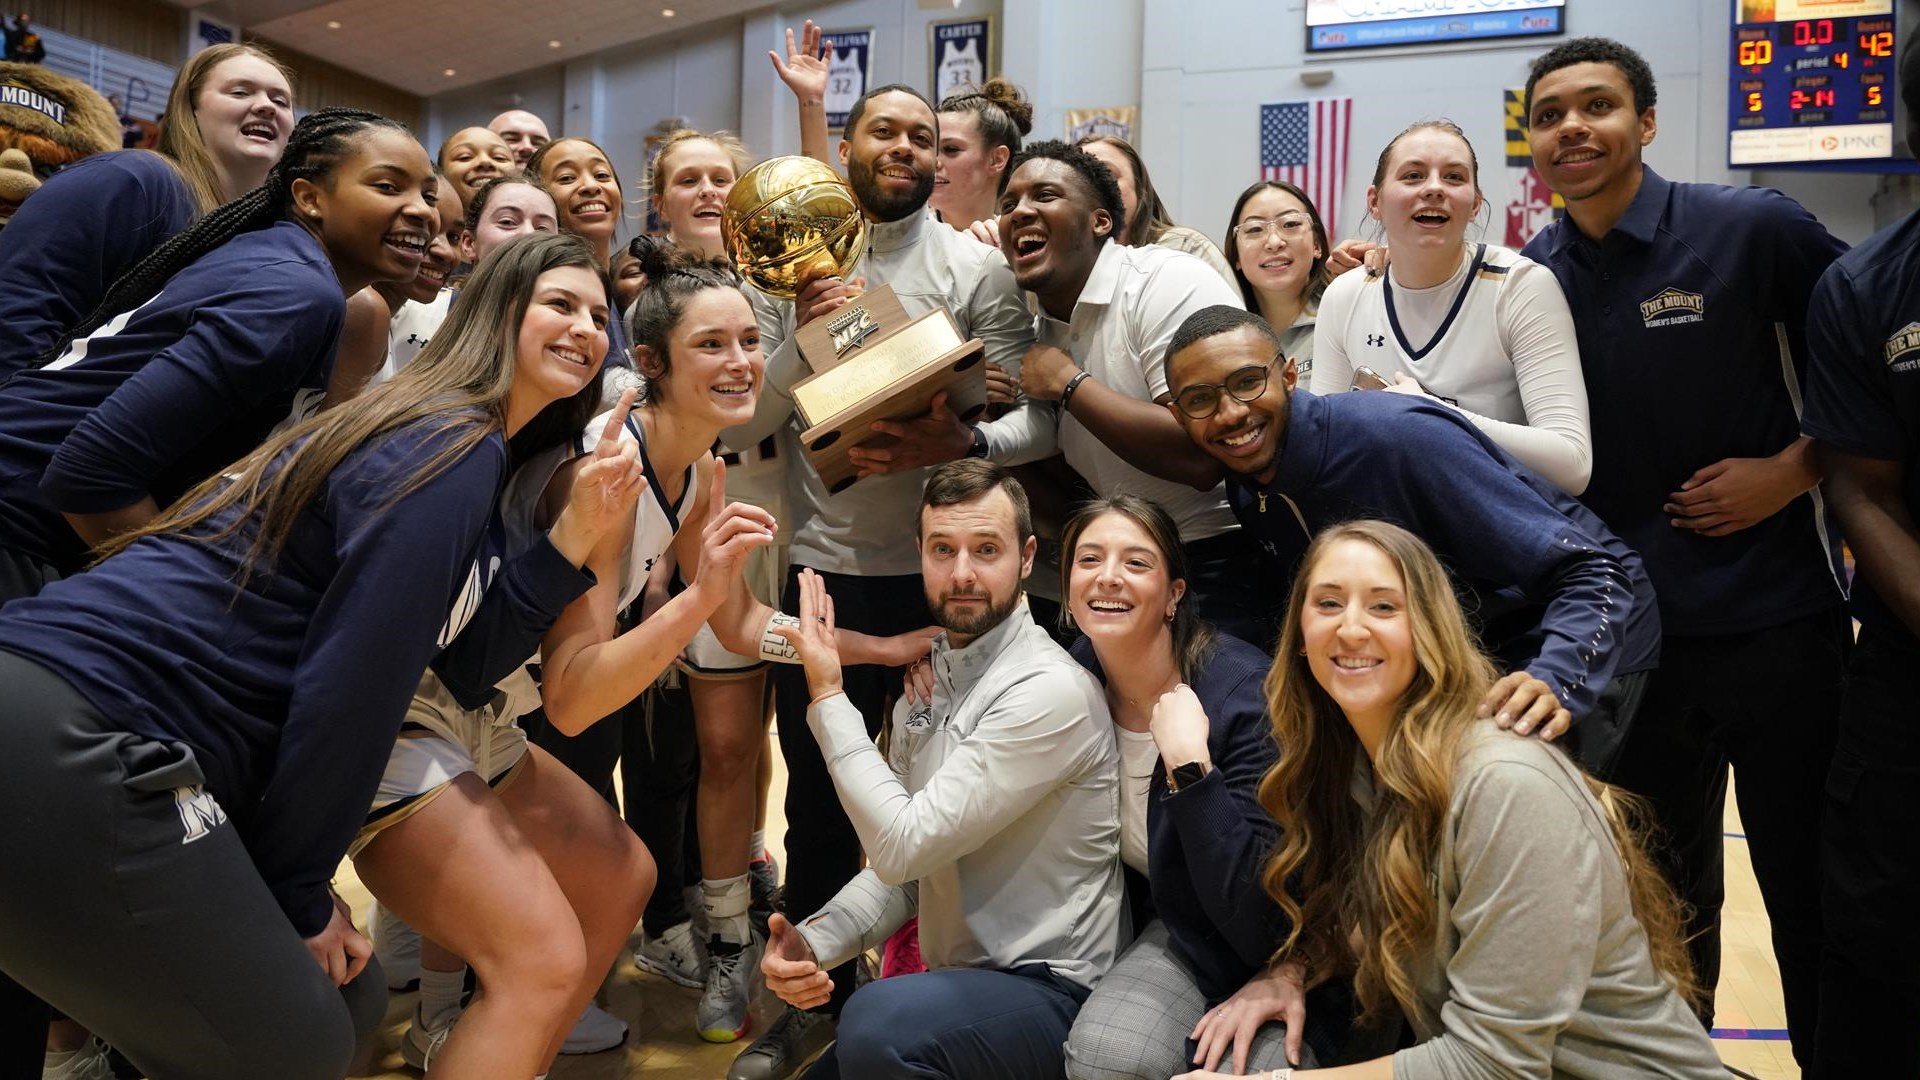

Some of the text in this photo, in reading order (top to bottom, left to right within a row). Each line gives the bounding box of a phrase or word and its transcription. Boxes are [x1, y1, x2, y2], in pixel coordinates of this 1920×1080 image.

[939, 23, 982, 39] CARTER
[1794, 20, 1833, 45] 0.0
[1739, 40, 1772, 65] 60
[1860, 32, 1893, 56] 42
[1796, 52, 1848, 69] period 4
[832, 79, 851, 94] 32
[2, 86, 65, 124] MOUNT
[1843, 135, 1885, 149] PNC
[826, 305, 862, 328] NORTHEAST
[1643, 295, 1701, 317] THE MOUNT
[833, 311, 871, 353] NEC
[1645, 314, 1703, 329] WOMEN'S BASKETBALL
